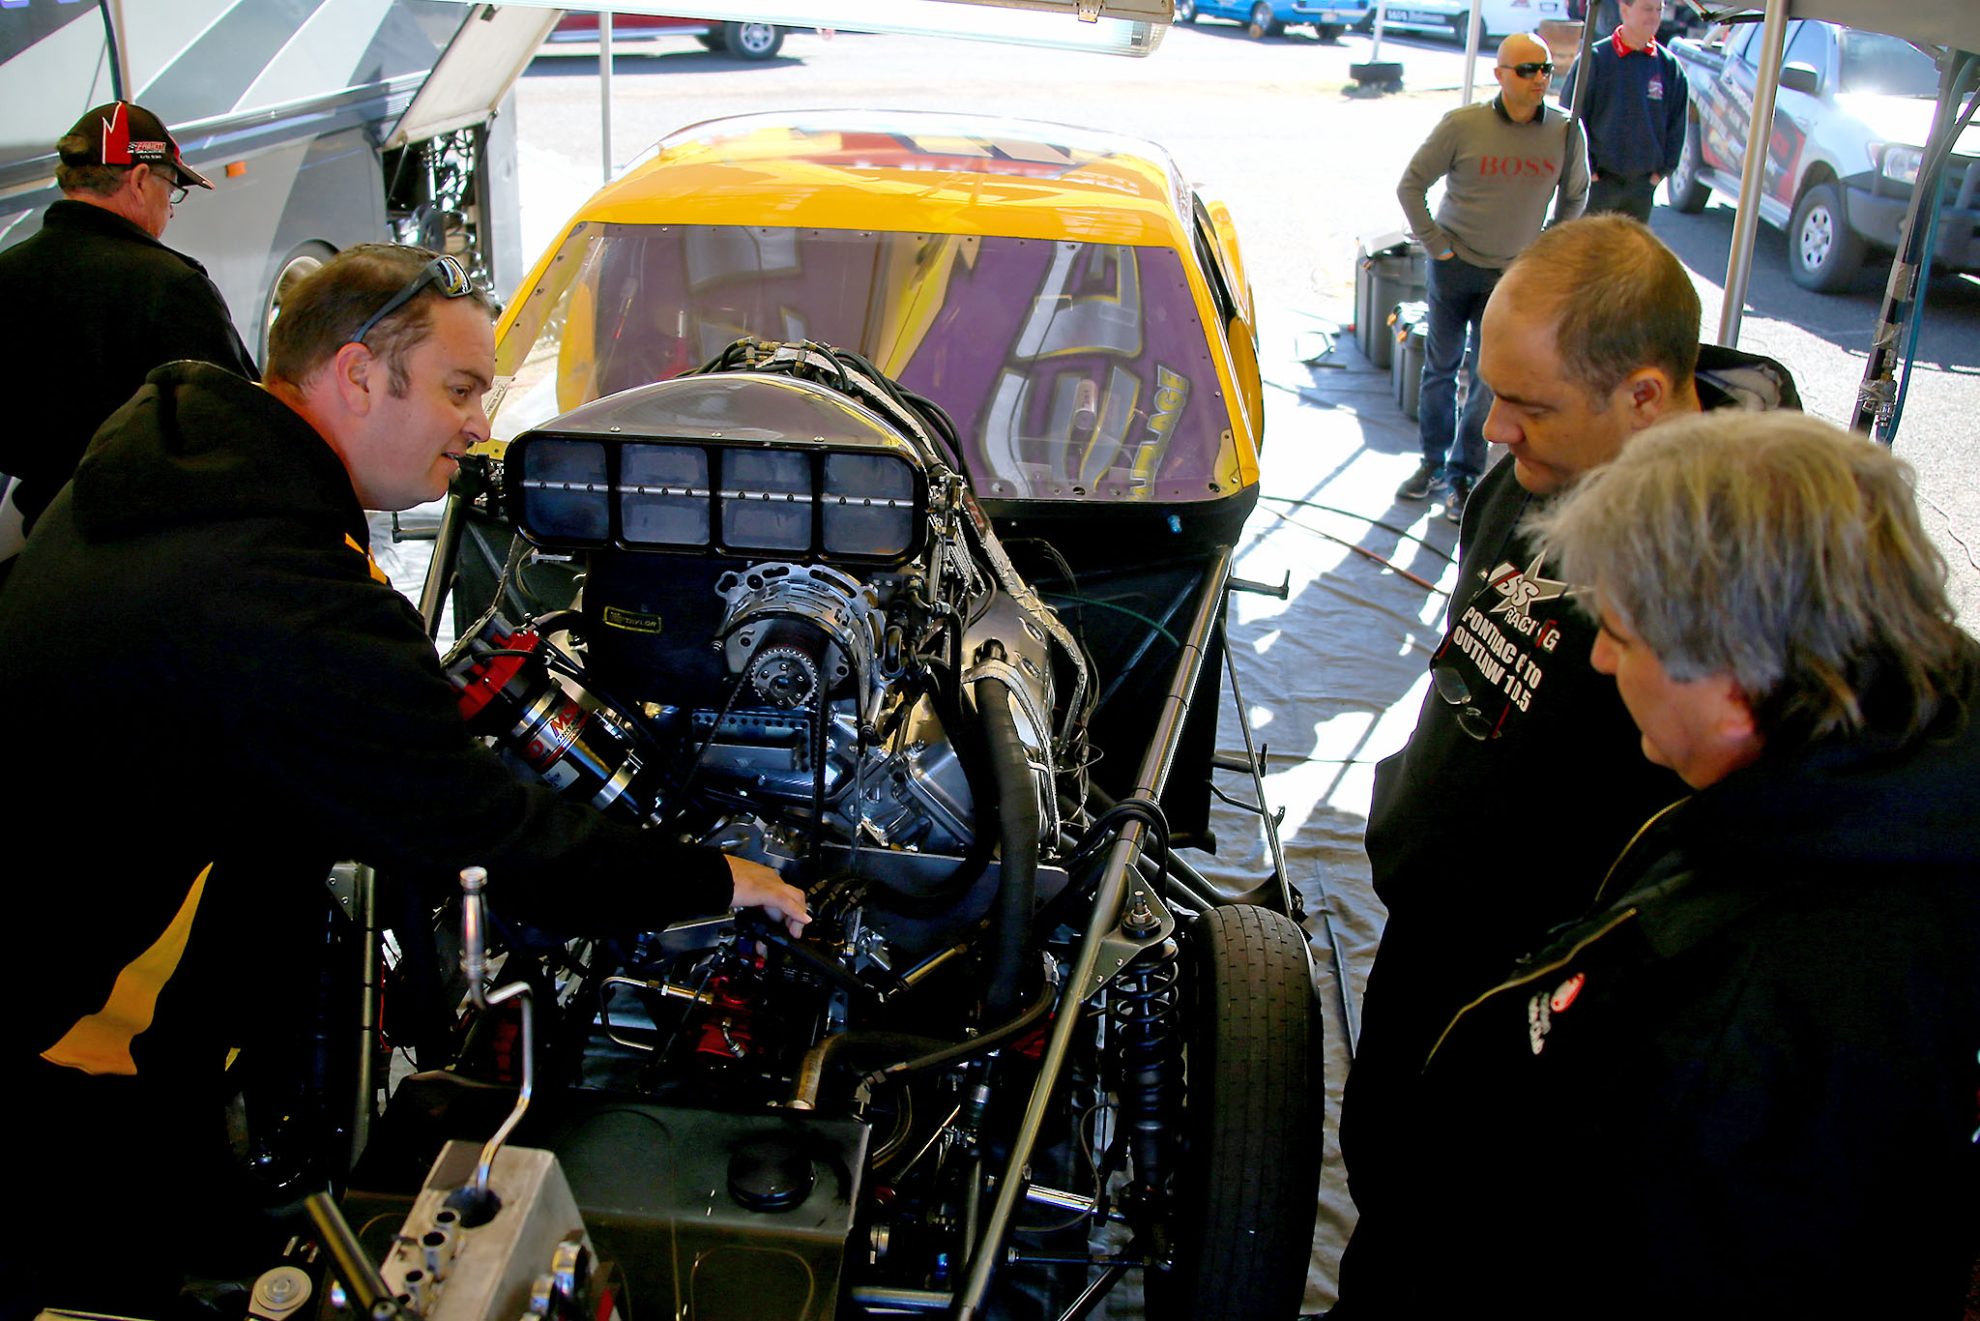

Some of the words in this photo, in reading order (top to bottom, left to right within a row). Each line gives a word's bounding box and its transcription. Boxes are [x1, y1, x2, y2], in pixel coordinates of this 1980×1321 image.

[1480, 155, 1556, 177] BOSS
[1461, 606, 1518, 664] PONTIAC
[1503, 606, 1561, 651] RACIG
[1452, 625, 1506, 686] OUTLAW
[1503, 674, 1532, 713] 10.5
